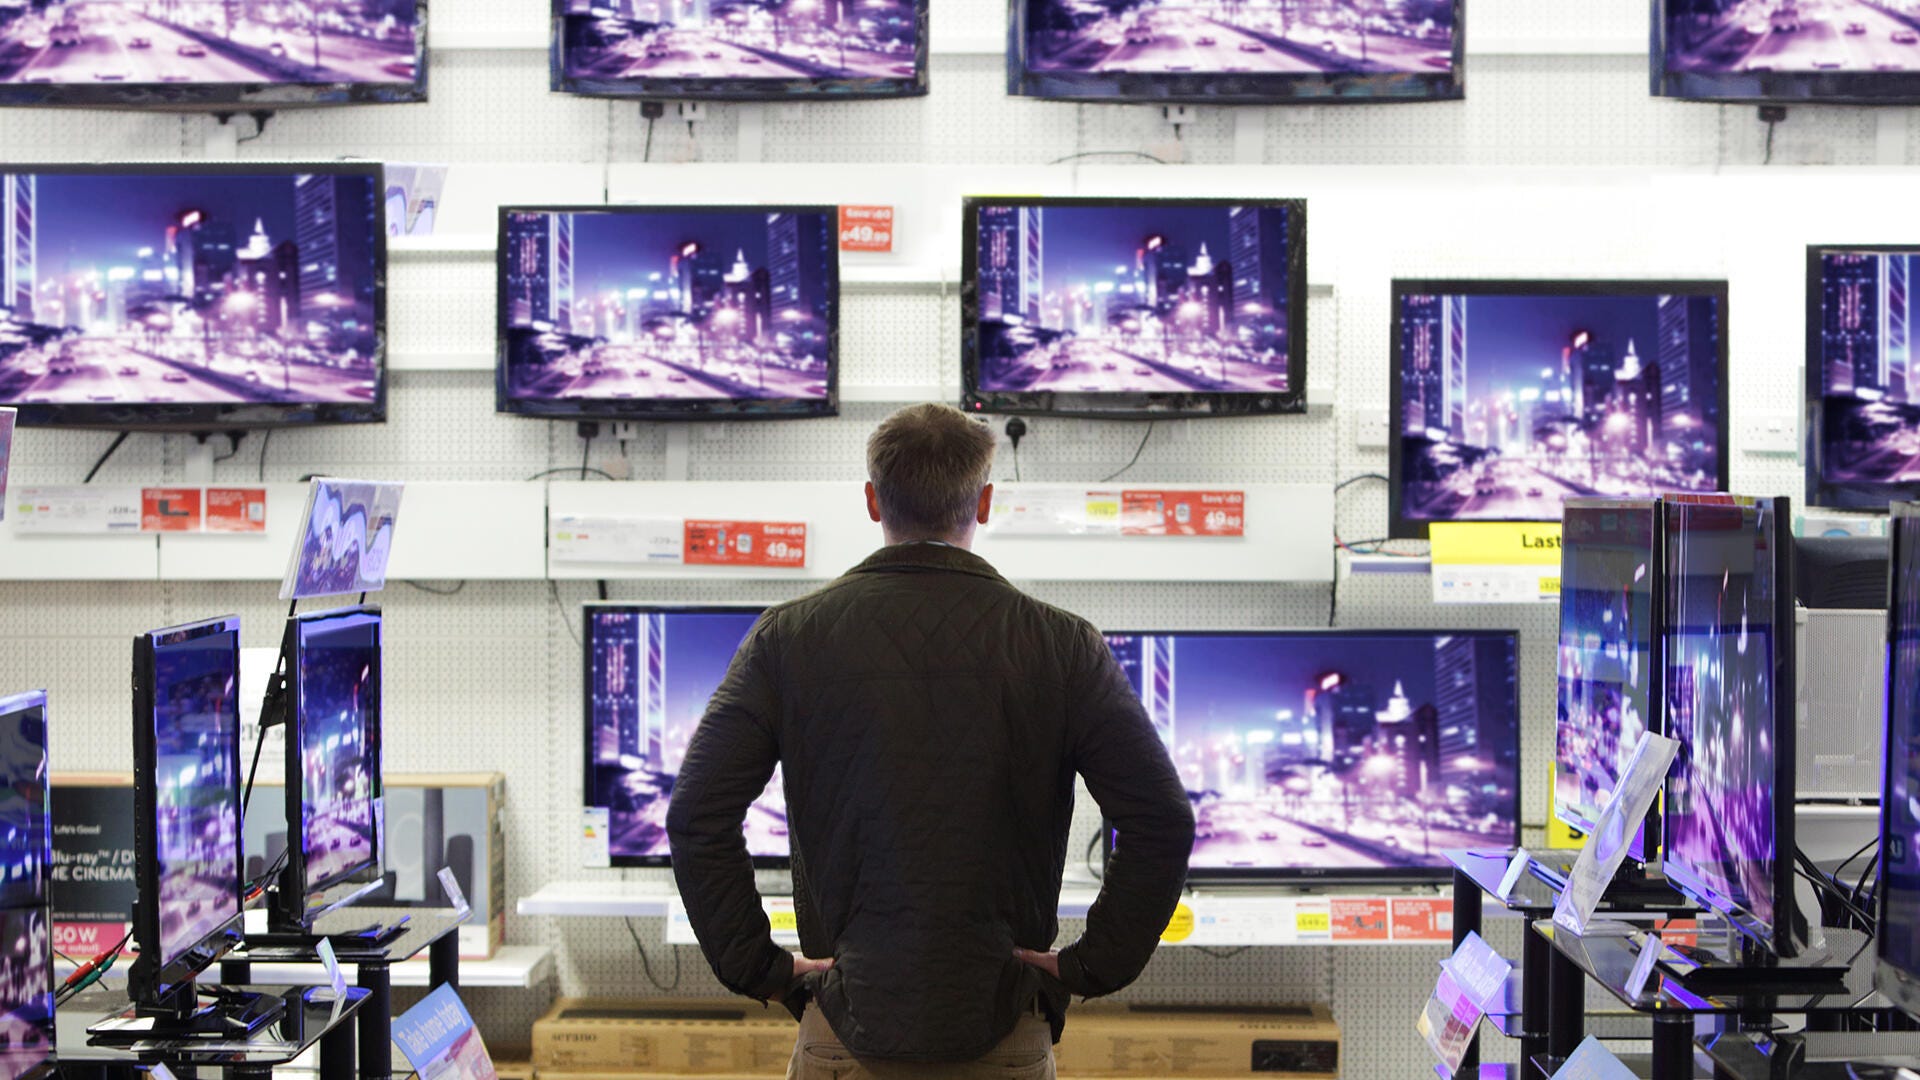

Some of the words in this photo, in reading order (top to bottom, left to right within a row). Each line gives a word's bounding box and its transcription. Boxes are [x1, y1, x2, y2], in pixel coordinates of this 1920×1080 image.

[1522, 534, 1561, 548] Last
[54, 825, 76, 835] Life's
[77, 825, 102, 835] Good
[72, 866, 135, 881] CINEMA
